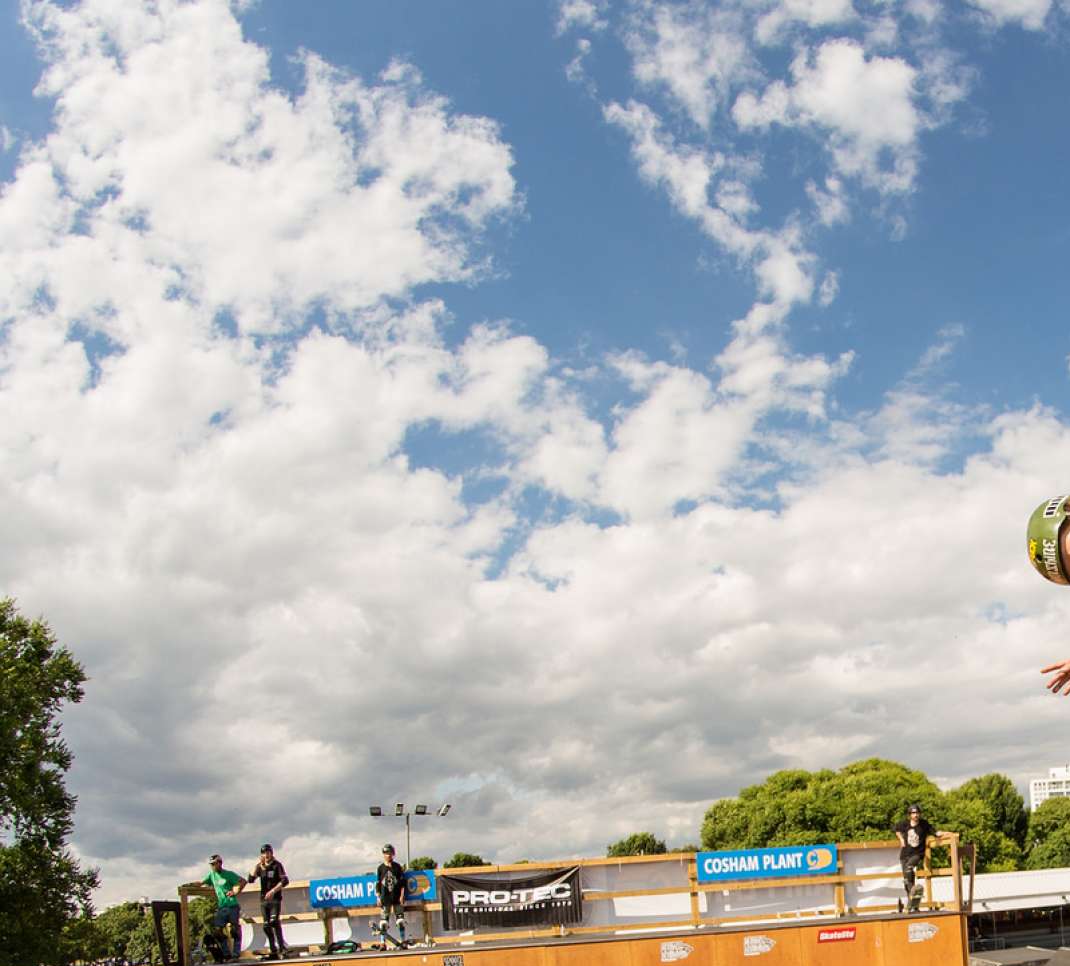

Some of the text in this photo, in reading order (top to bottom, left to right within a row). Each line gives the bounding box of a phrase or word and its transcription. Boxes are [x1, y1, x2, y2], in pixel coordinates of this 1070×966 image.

[704, 852, 803, 874] COSHAM PLANT
[316, 882, 364, 901] COSHAM
[452, 883, 572, 906] PRO-TEC
